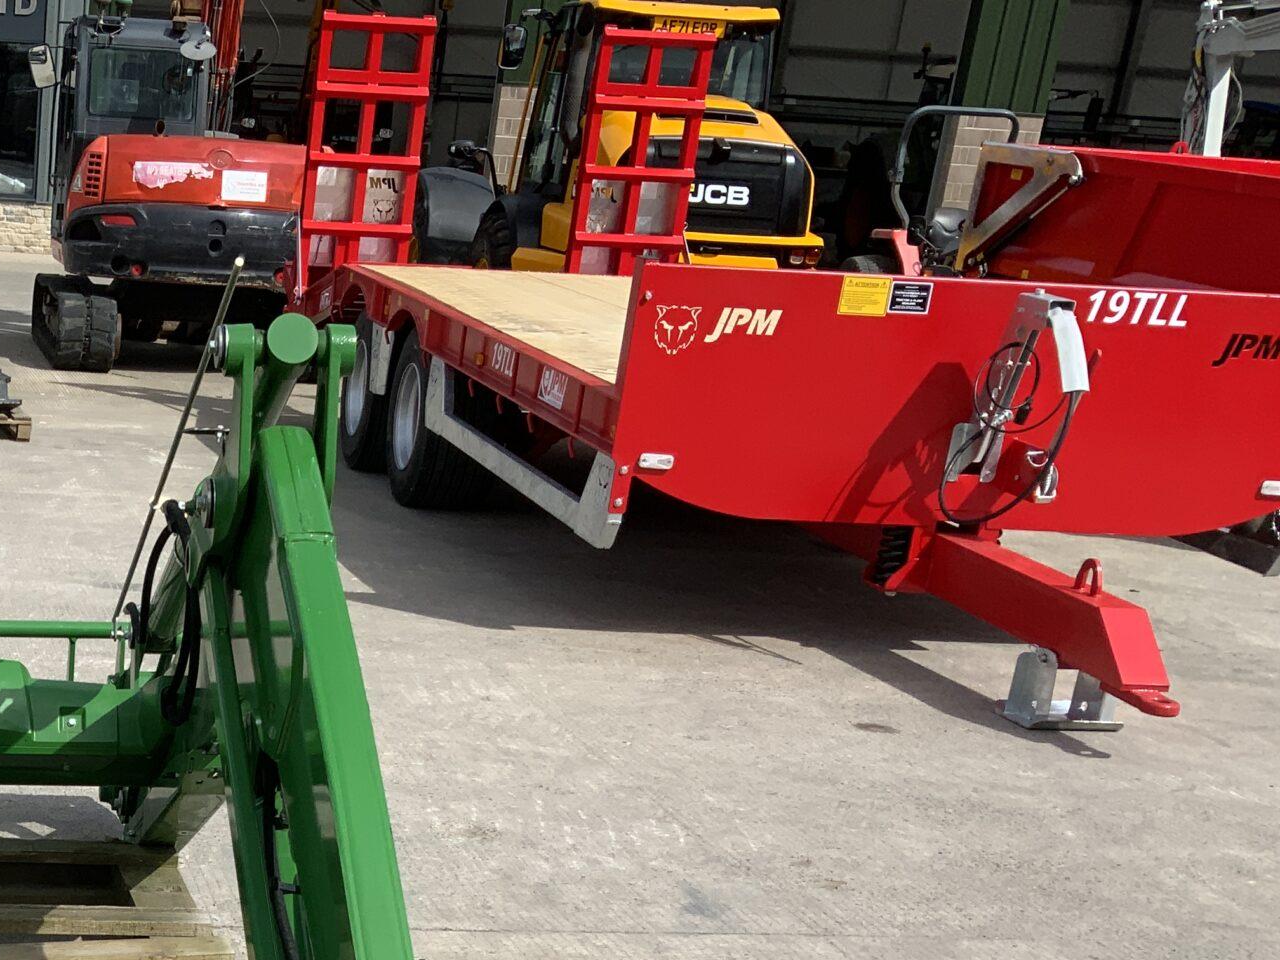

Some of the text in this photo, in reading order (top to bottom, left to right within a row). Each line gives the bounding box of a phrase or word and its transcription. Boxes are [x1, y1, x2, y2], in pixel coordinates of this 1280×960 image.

[688, 183, 750, 206] JCB
[704, 306, 784, 343] JPM
[1086, 289, 1189, 328] 19TLL
[1211, 333, 1280, 367] JPM
